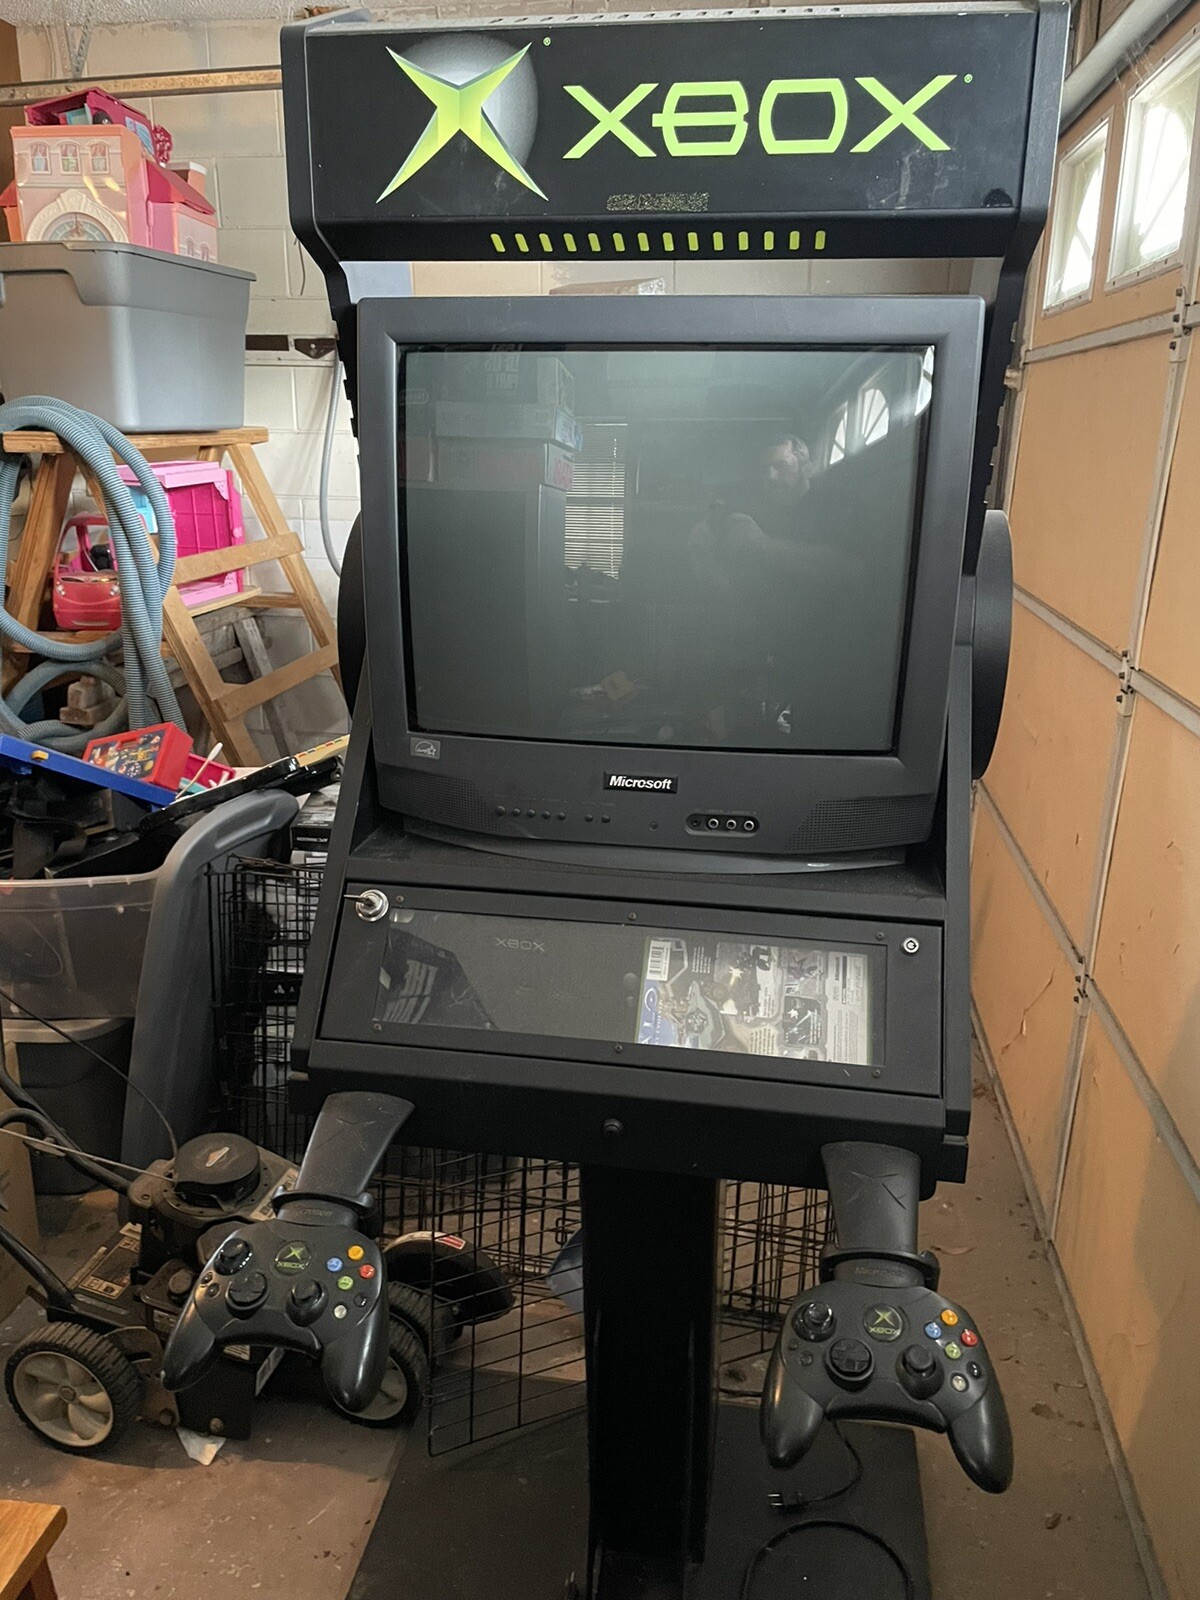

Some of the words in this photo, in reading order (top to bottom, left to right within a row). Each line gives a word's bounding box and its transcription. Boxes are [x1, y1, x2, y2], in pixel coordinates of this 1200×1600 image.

[563, 74, 957, 159] XBOX
[609, 774, 672, 791] Microsoft
[494, 936, 545, 952] XBOX
